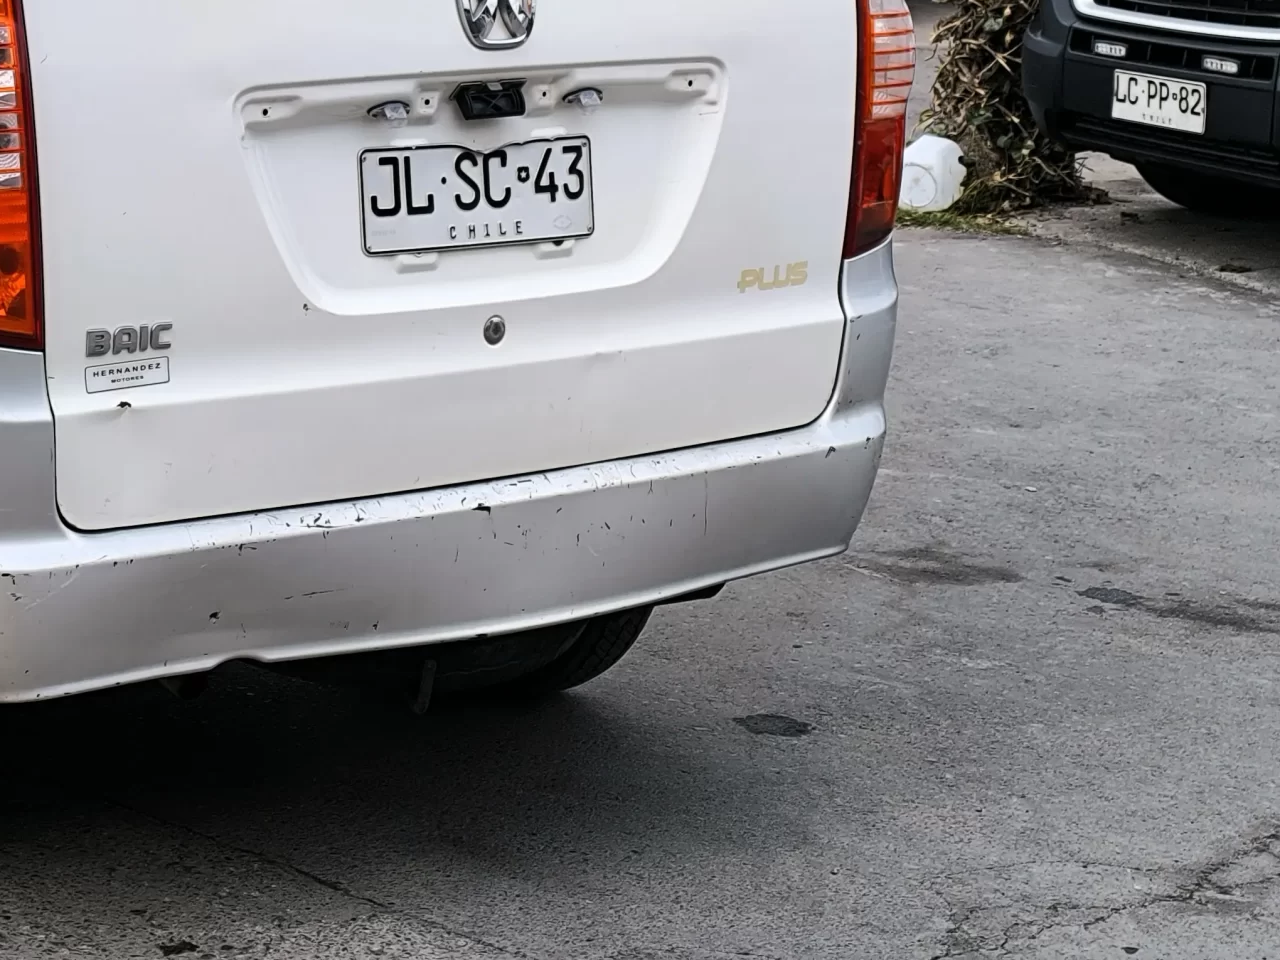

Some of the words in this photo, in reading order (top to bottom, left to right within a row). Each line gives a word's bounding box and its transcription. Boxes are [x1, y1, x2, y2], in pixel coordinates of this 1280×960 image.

[449, 220, 524, 240] CHILE
[736, 260, 809, 294] PLUS
[86, 322, 172, 357] BAIC
[93, 362, 161, 377] HERNANDEZ
